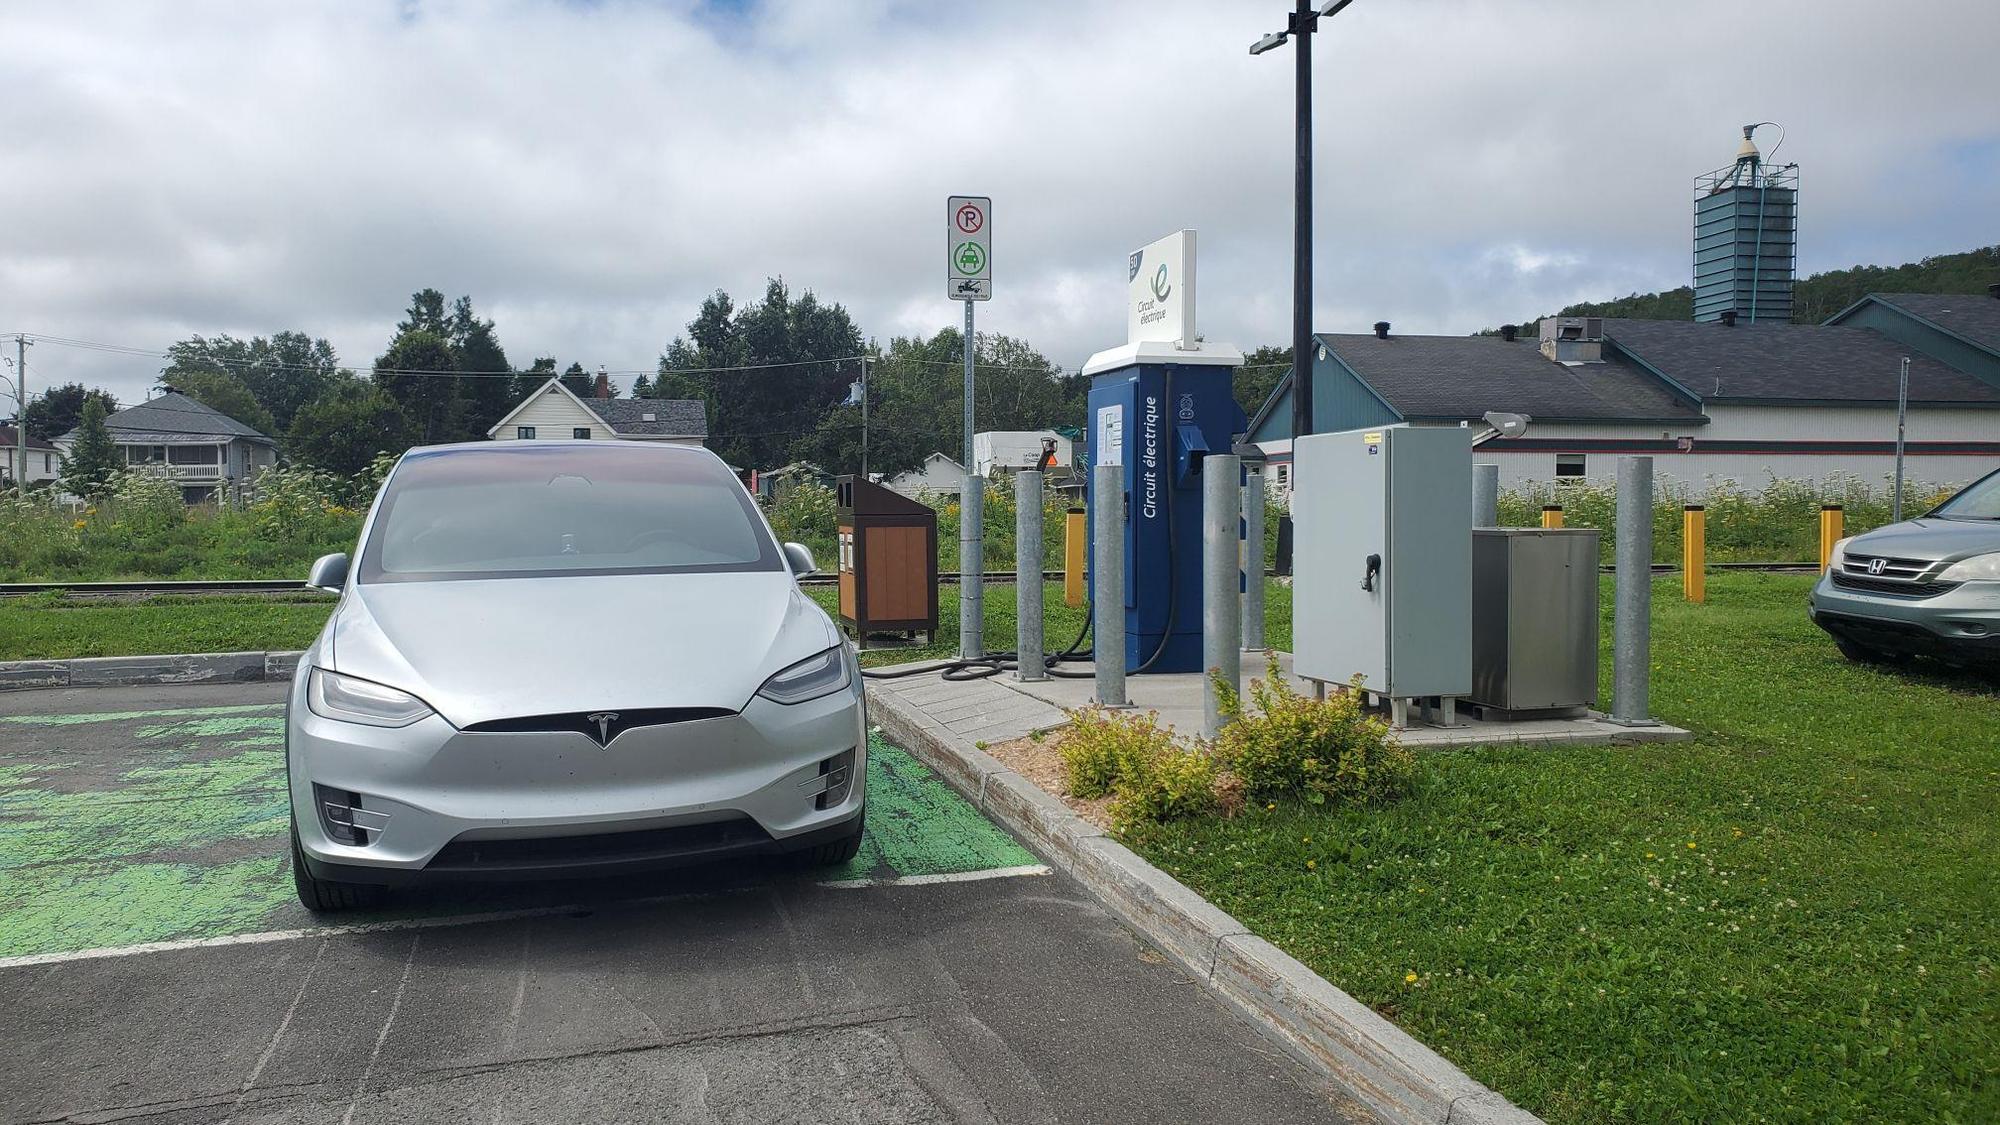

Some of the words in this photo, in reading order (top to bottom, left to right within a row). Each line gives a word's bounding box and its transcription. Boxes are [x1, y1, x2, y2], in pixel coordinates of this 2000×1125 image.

[1138, 299, 1154, 312] Circuit
[1143, 396, 1159, 468] électrique
[1143, 472, 1156, 518] Circuit
